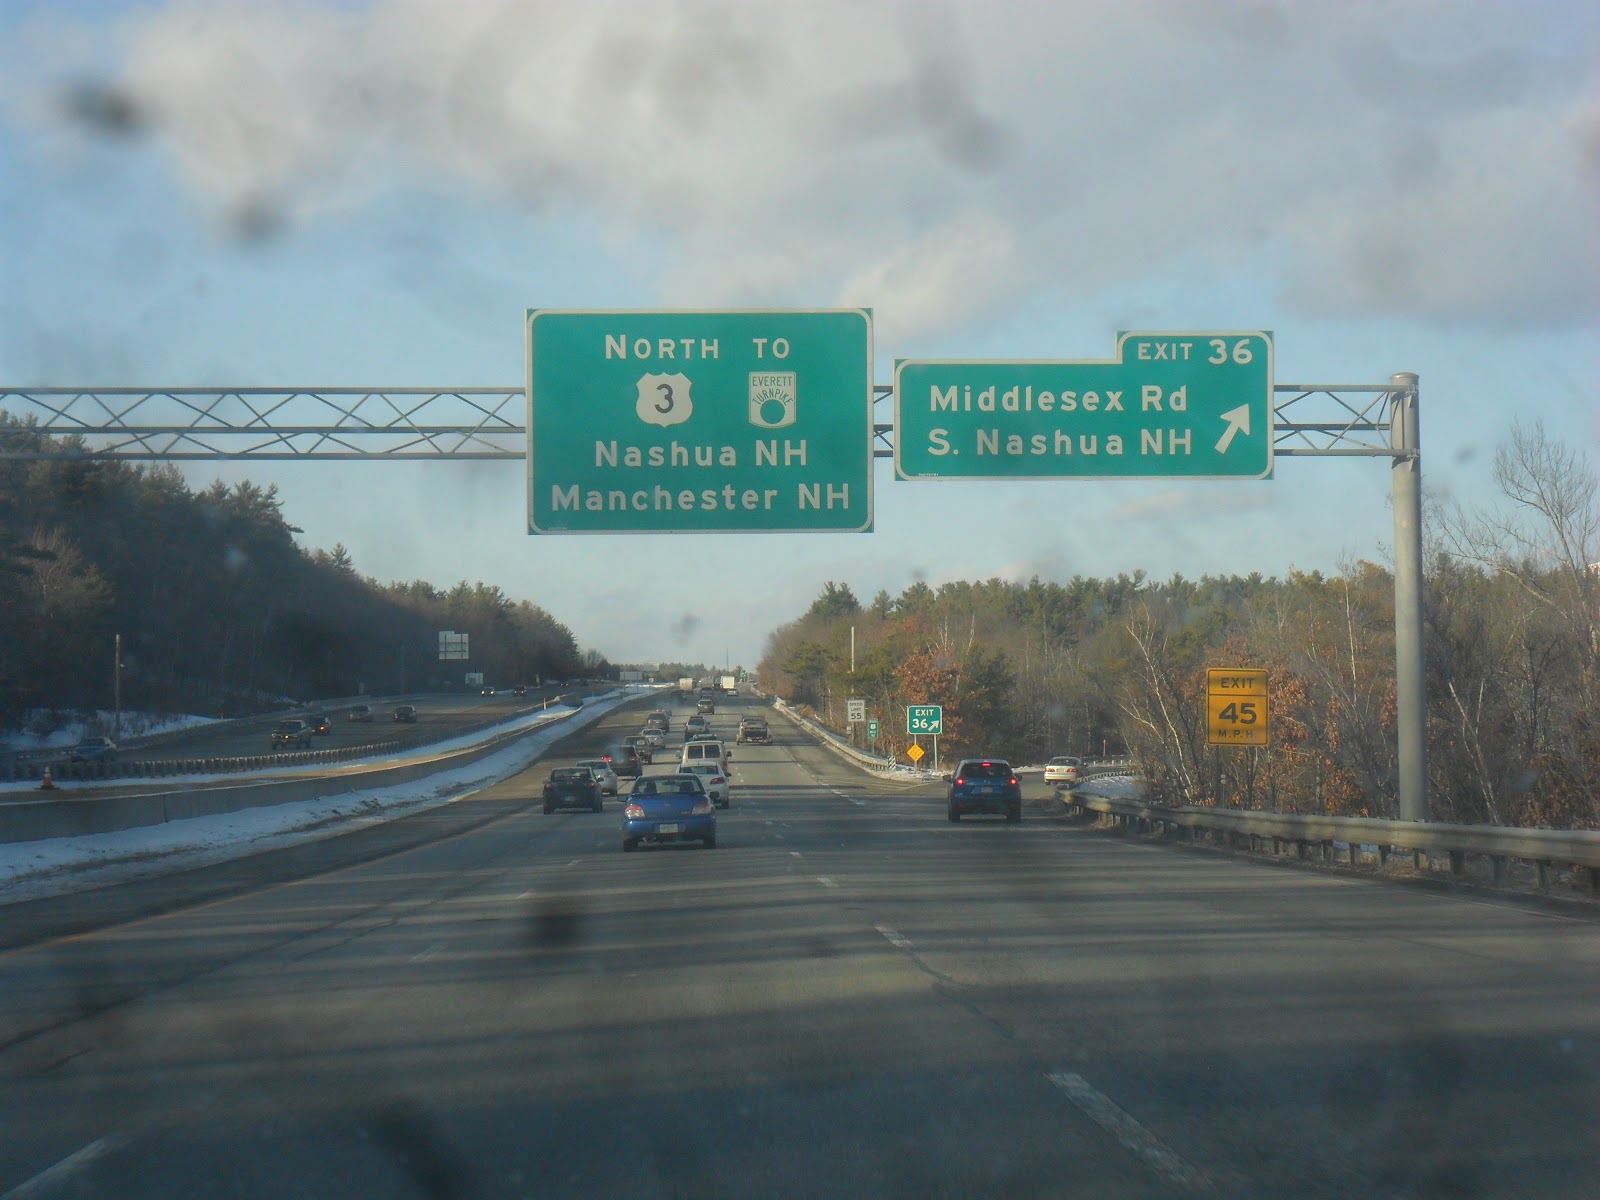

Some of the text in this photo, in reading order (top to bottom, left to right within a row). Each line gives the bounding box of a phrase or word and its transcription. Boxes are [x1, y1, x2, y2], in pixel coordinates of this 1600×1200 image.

[605, 334, 790, 359] NORTH TO
[1137, 338, 1252, 365] EXIT 36
[752, 376, 792, 387] EVERETT
[654, 383, 674, 414] 3
[752, 388, 793, 406] TURNPIKE
[930, 384, 1187, 412] Middlesex Rd
[595, 439, 807, 467] Nashua NH
[927, 428, 1192, 456] S. Nashua NH
[551, 482, 849, 511] Manchester NH
[1221, 678, 1255, 688] EXIT
[912, 718, 928, 729] 36
[1219, 702, 1257, 725] 45
